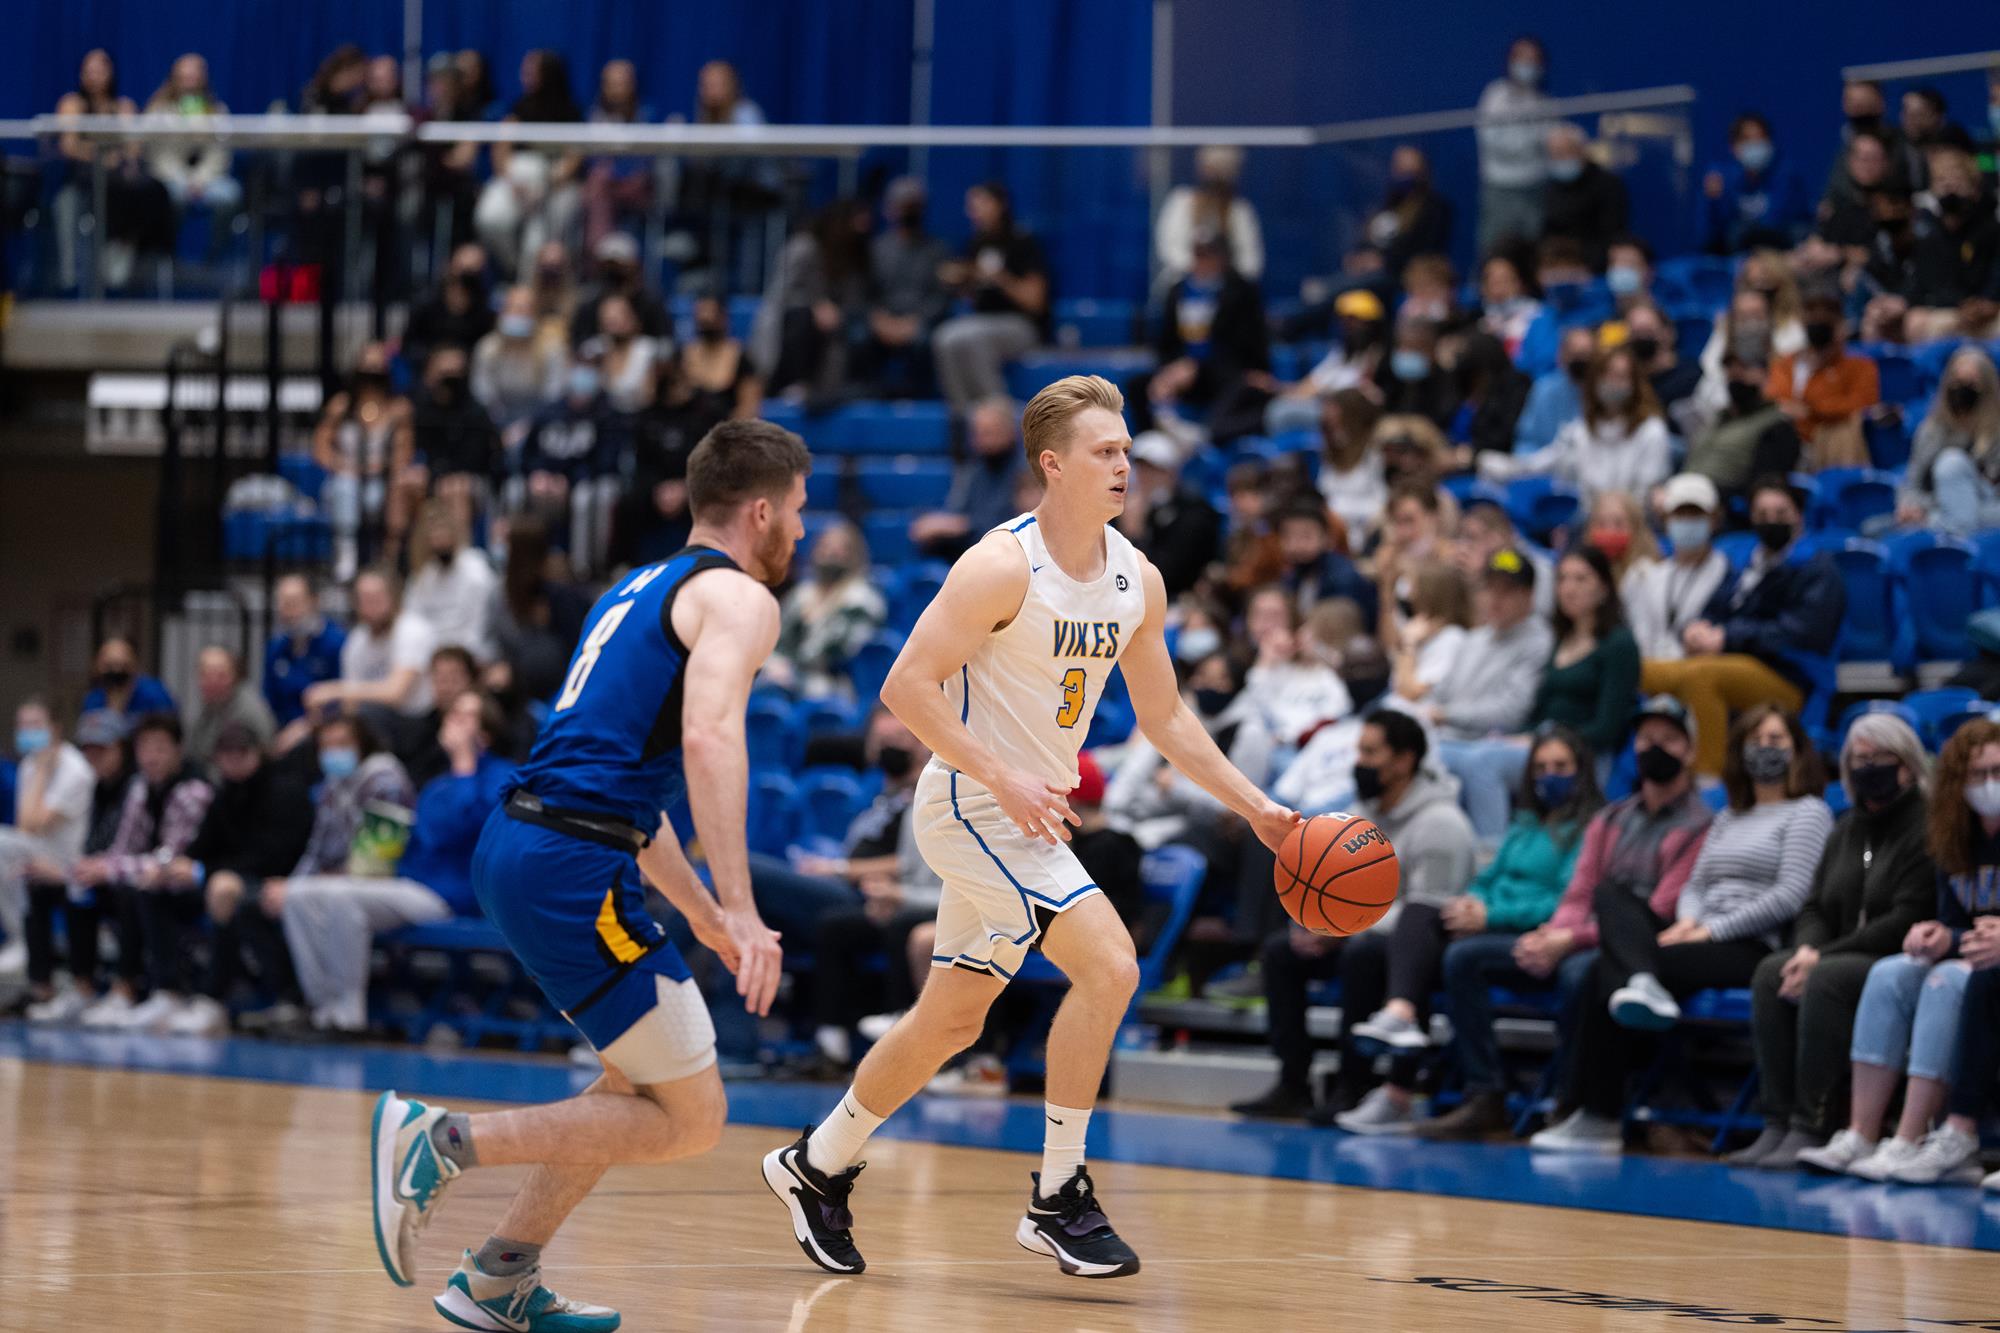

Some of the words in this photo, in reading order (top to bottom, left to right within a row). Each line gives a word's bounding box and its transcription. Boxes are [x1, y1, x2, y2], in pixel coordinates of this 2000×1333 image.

[555, 599, 635, 712] 8
[1053, 620, 1120, 658] VIKES
[1056, 668, 1087, 729] 3
